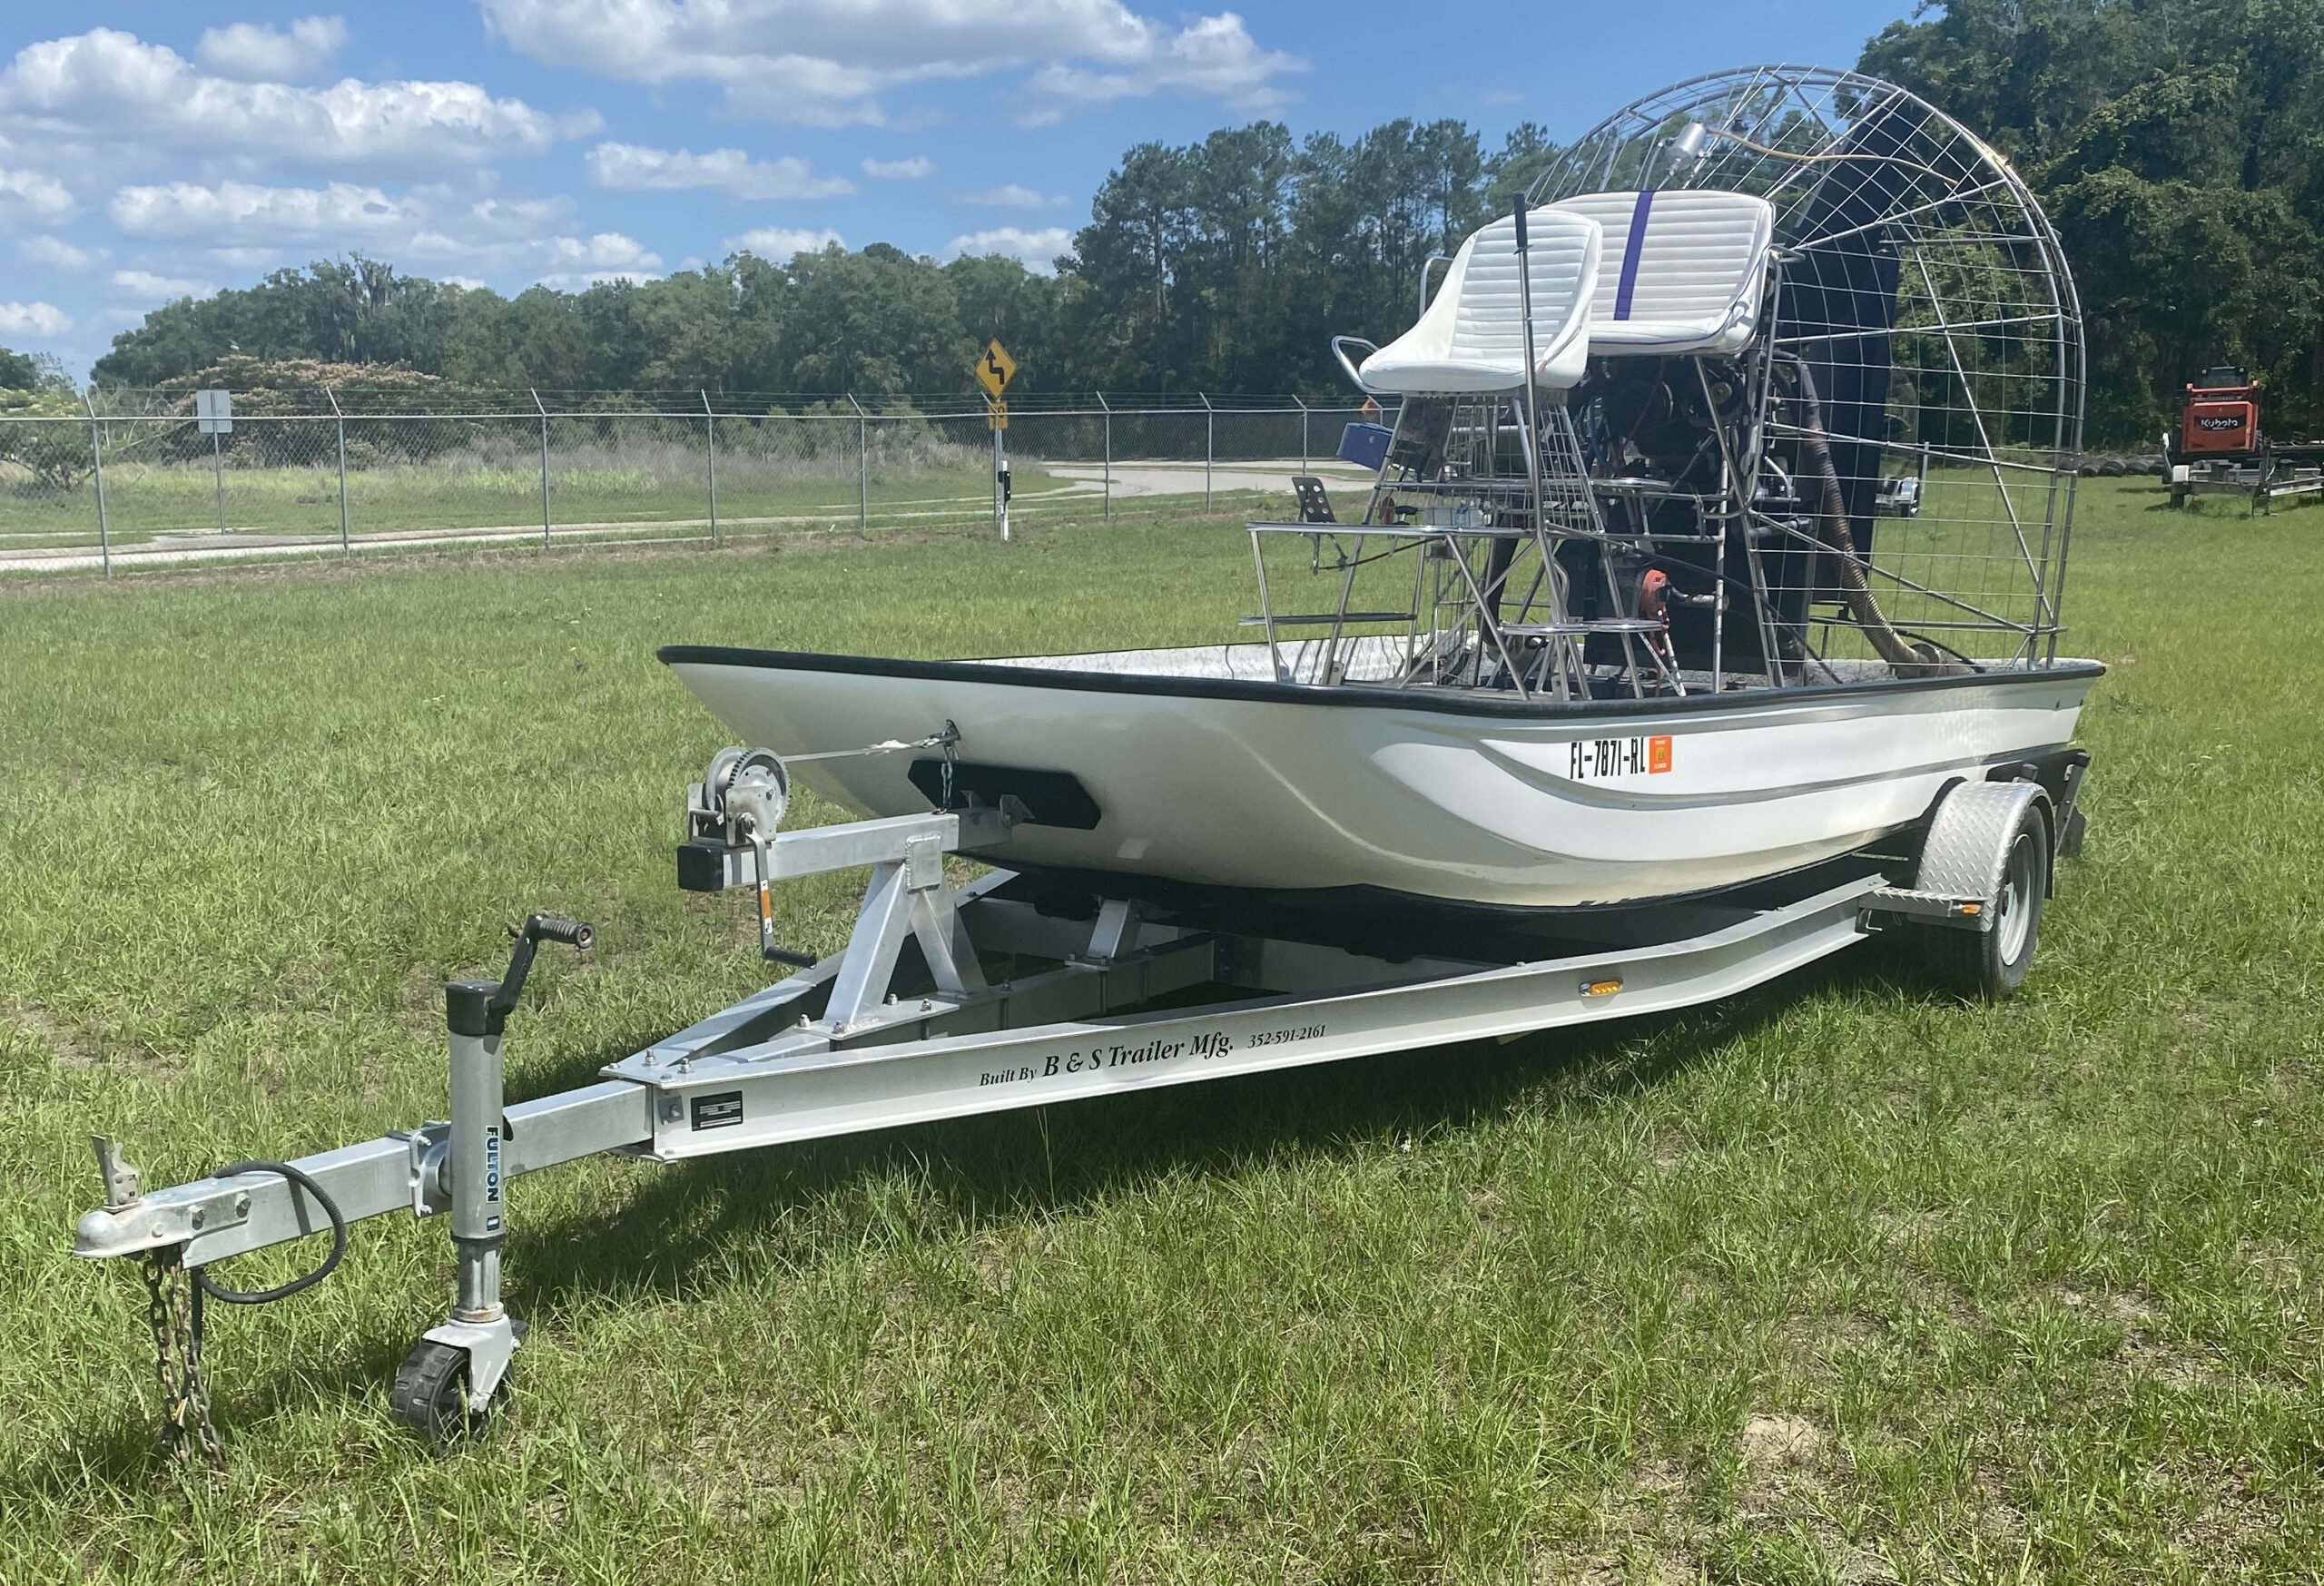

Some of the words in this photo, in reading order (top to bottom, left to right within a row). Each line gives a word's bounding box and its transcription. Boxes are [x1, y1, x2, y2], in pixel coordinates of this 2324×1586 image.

[2201, 418, 2238, 429] Kubota
[1570, 737, 1646, 780] FL-7871-RL
[980, 1069, 1015, 1087] Built
[1019, 1067, 1038, 1083] By
[1041, 1055, 1060, 1078] B
[1066, 1052, 1084, 1073] &
[1088, 1049, 1103, 1070] S
[1108, 1039, 1186, 1067] Trailer
[1188, 1031, 1235, 1060] Mfg.
[1247, 1024, 1326, 1049] 352-591-2161
[486, 1126, 499, 1203] FULTON
